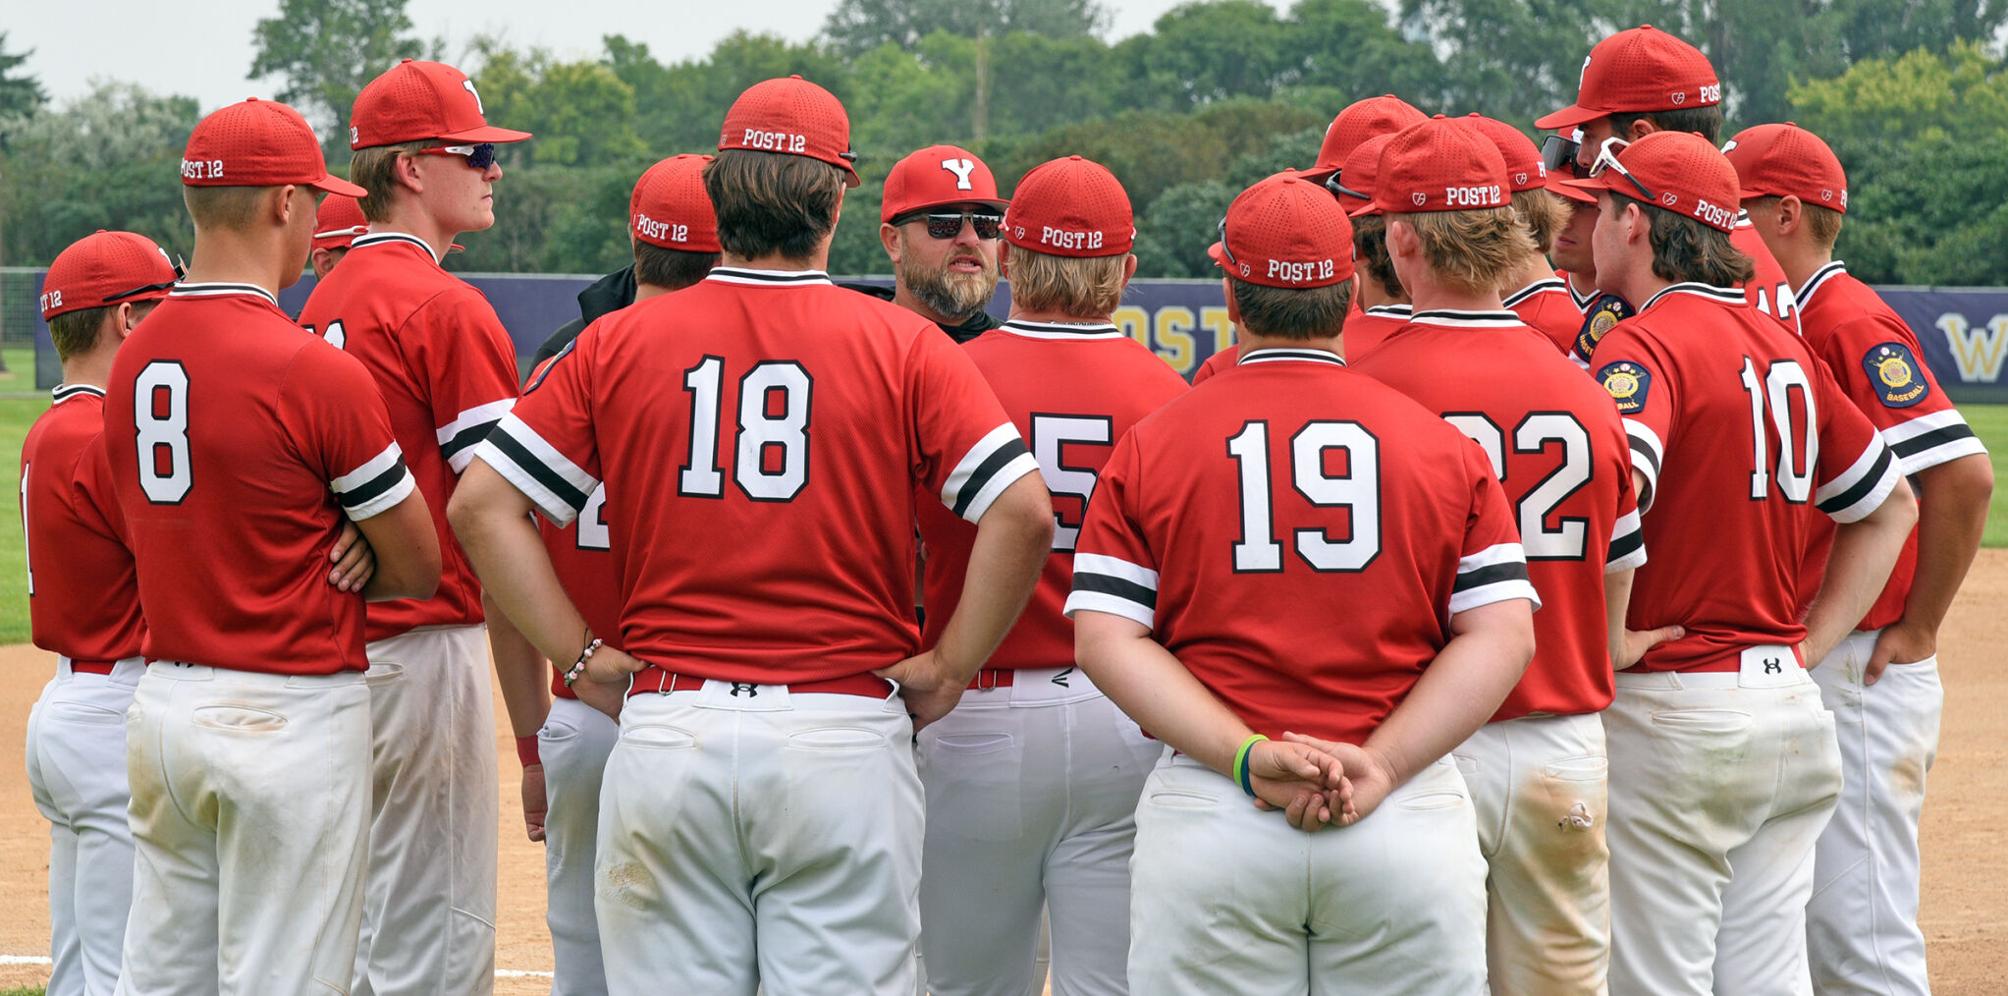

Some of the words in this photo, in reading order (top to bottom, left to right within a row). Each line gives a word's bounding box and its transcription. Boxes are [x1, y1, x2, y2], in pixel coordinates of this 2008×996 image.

[742, 128, 786, 151] POST
[788, 133, 806, 153] 12
[206, 159, 224, 178] 12
[941, 158, 975, 191] Y
[1446, 186, 1489, 206] POST
[1489, 184, 1501, 204] 12
[637, 213, 669, 240] POST
[671, 223, 688, 243] 12
[1693, 199, 1731, 228] POST
[1041, 226, 1086, 250] POST
[1087, 231, 1103, 249] 12
[1267, 258, 1315, 281] POST
[1318, 258, 1334, 280] 12
[49, 289, 63, 309] 12
[1934, 312, 2008, 383] W
[1886, 384, 1925, 403] BASEBALL
[133, 359, 194, 505] 8
[677, 353, 814, 503] 18
[1739, 354, 1820, 504] 10
[1030, 412, 1114, 554] 5
[1225, 419, 1383, 574] 19
